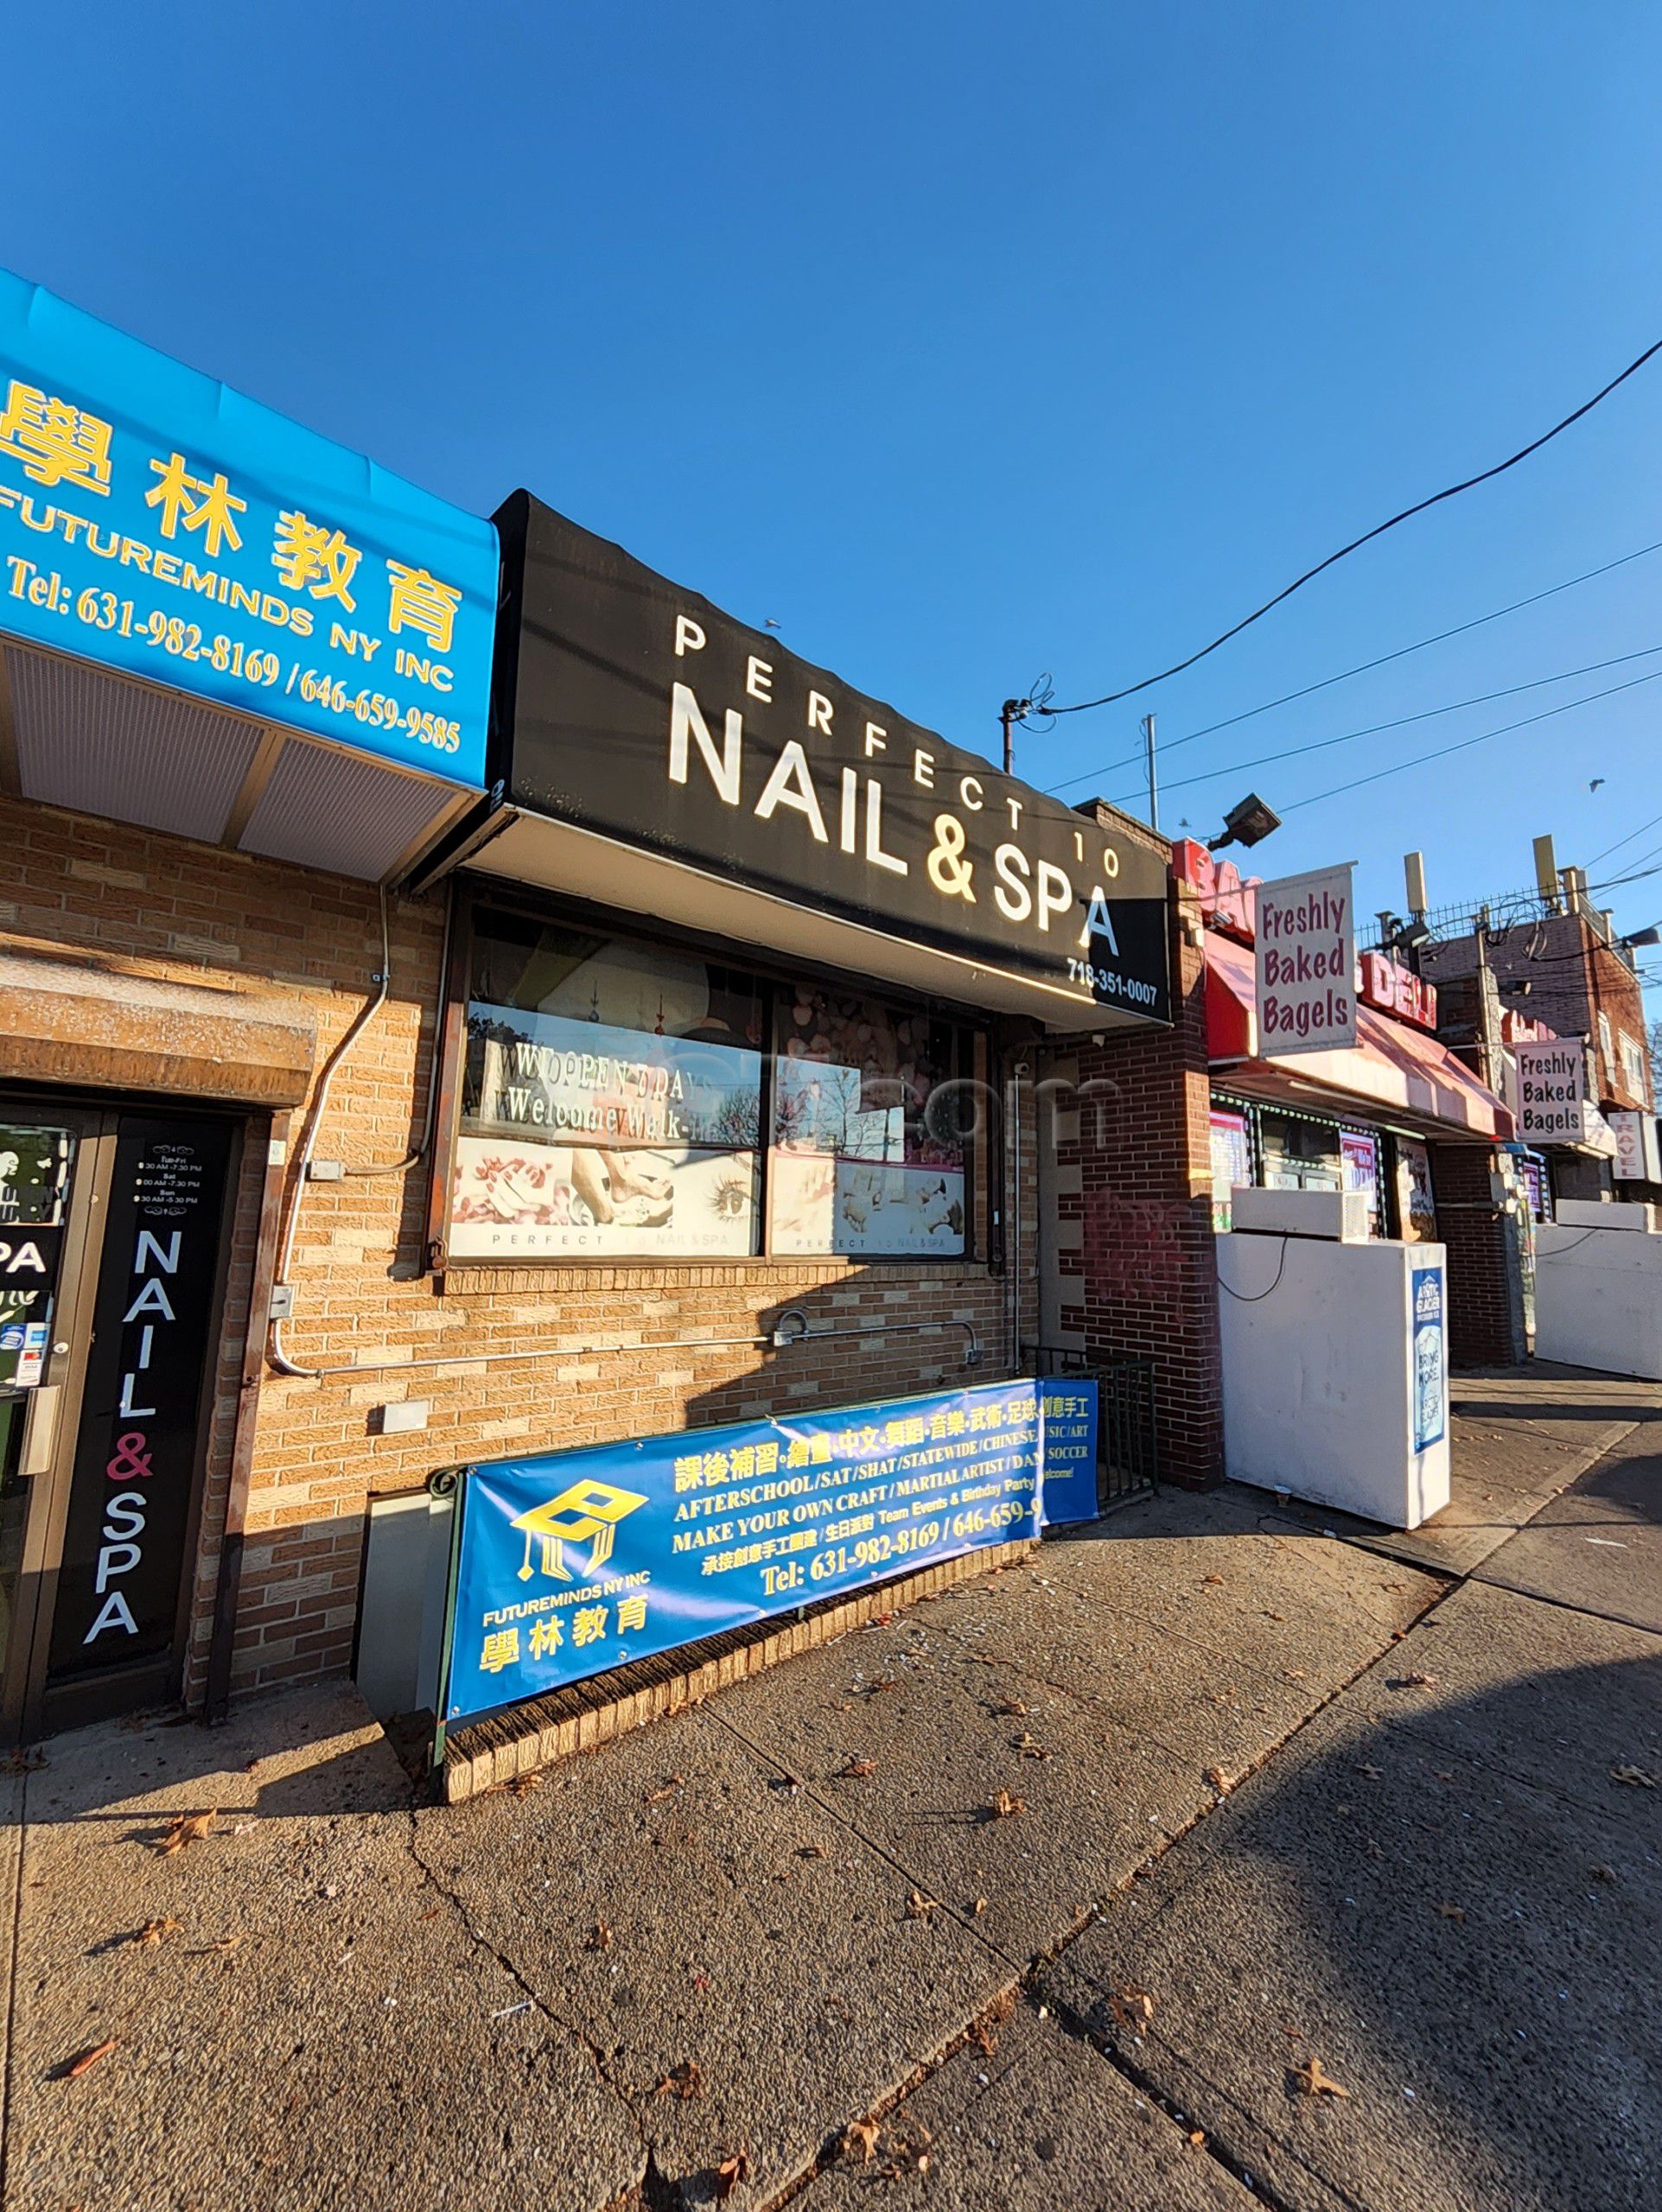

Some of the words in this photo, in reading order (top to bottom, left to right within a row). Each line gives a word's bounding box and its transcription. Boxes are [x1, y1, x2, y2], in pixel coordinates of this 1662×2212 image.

[7, 555, 71, 616] Tel:
[76, 587, 281, 687] 631-982-8169
[301, 669, 462, 754] 646-659-9585
[329, 622, 381, 662] NY
[395, 648, 454, 691] INC
[674, 614, 1022, 830] PERFECT
[669, 682, 907, 876] NAIL
[927, 813, 977, 903] &
[994, 843, 1119, 957] SPA
[1263, 891, 1346, 941] Freshly
[1067, 957, 1157, 1007] 718-351-0007
[1264, 938, 1346, 988] Baked
[1263, 988, 1348, 1038] Bagels
[1520, 1052, 1576, 1077] Freshly
[1523, 1079, 1576, 1103] Baked
[1523, 1107, 1580, 1135] Bagels
[492, 1234, 603, 1246] PERFECT
[120, 1230, 180, 1419] NAIL
[106, 1433, 154, 1480] &
[1048, 1445, 1088, 1460] SOCCER
[672, 1526, 735, 1554] MAKE
[738, 1510, 791, 1543] YOUR
[793, 1500, 835, 1524] OWN
[835, 1486, 888, 1514] CRAFT
[896, 1471, 959, 1498] MARTIAL
[958, 1462, 1004, 1483] ARTIST
[878, 1507, 909, 1528] Team
[911, 1497, 948, 1516] Events
[961, 1484, 1002, 1505] Birthday
[1003, 1478, 1035, 1493] Party
[83, 1492, 147, 1644] SPA
[760, 1562, 806, 1597] Tel:
[809, 1522, 940, 1581] 631-982-8169
[482, 1584, 602, 1628] FUTUREMINDS
[603, 1577, 627, 1596] NY
[626, 1570, 651, 1589] INC
[479, 1593, 650, 1674] 學林教育
